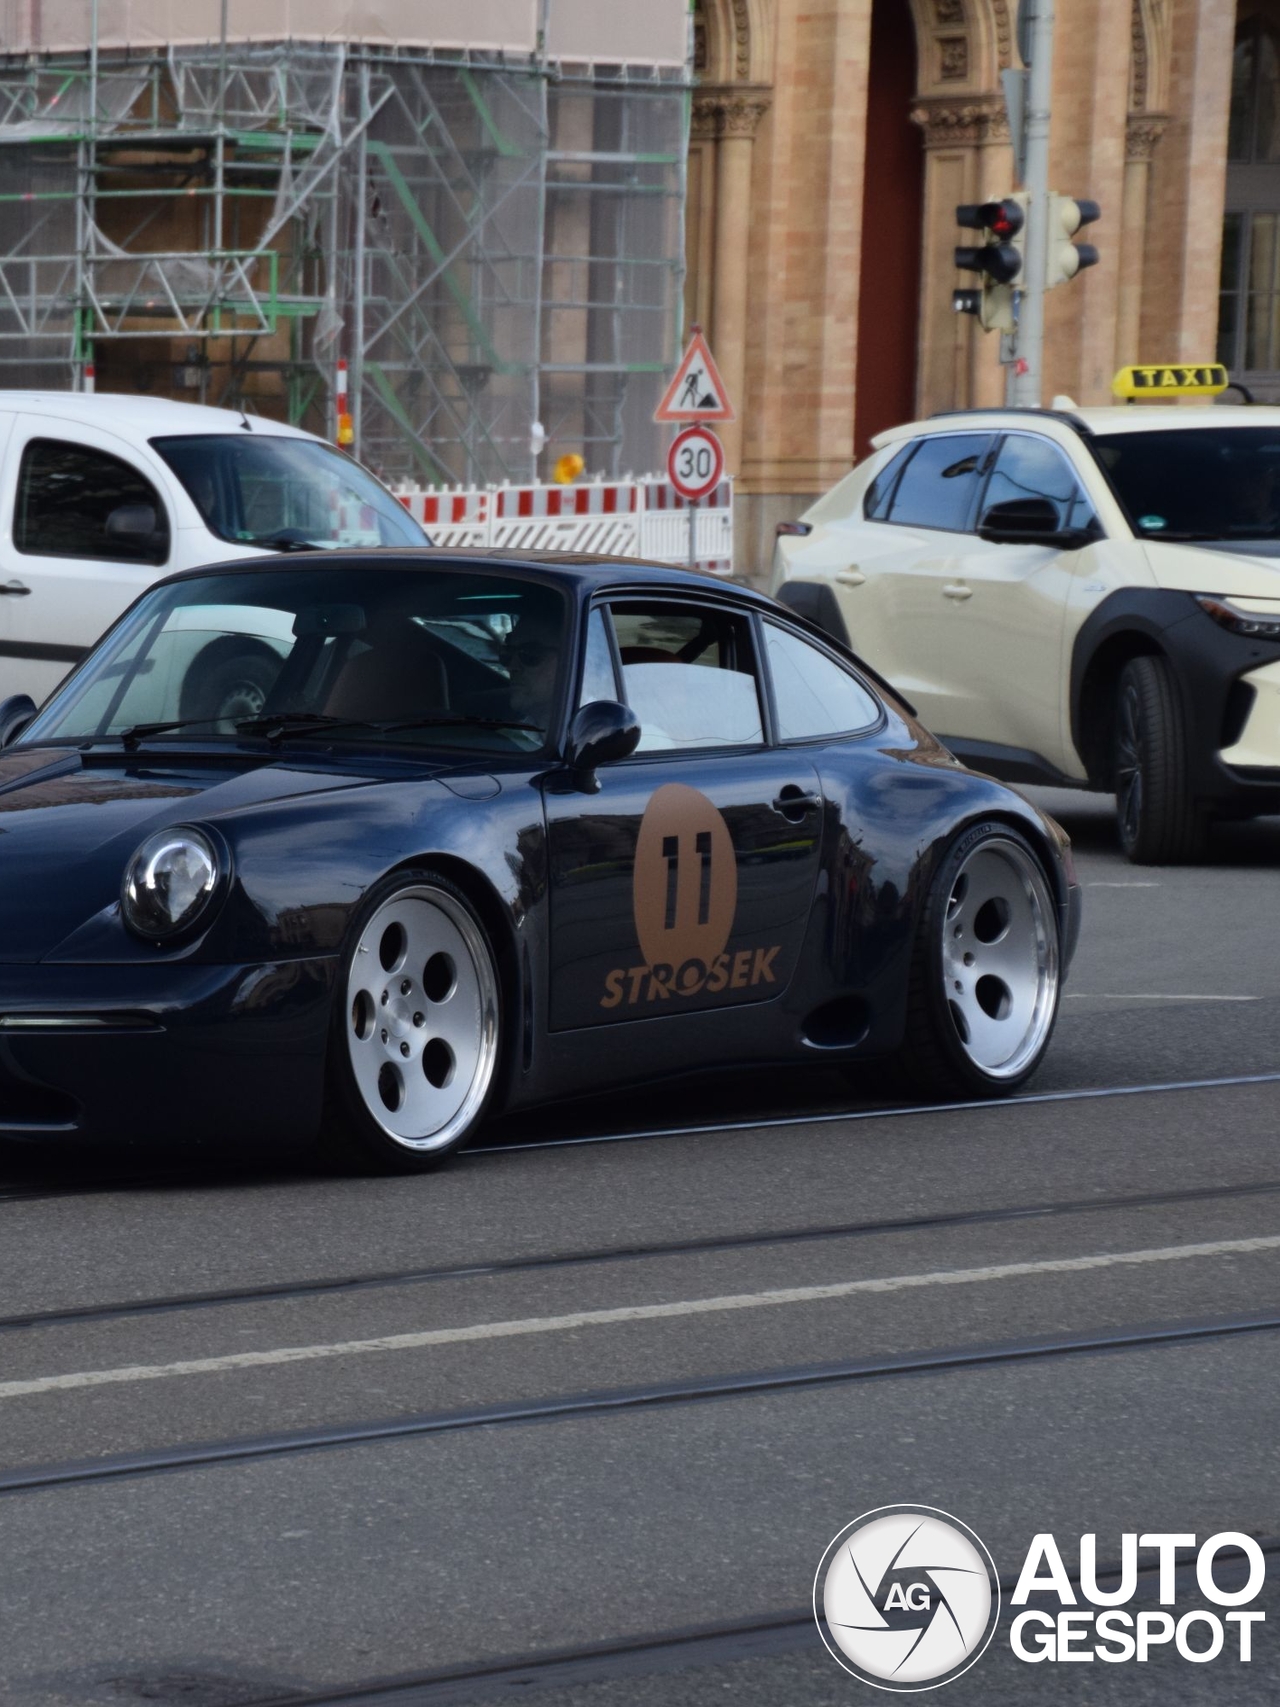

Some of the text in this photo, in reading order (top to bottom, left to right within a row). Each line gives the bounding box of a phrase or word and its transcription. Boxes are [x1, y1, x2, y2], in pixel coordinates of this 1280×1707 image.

[1141, 369, 1214, 387] TAXI
[680, 447, 711, 479] 30
[662, 831, 712, 931] 11
[599, 946, 782, 1008] STROSEK
